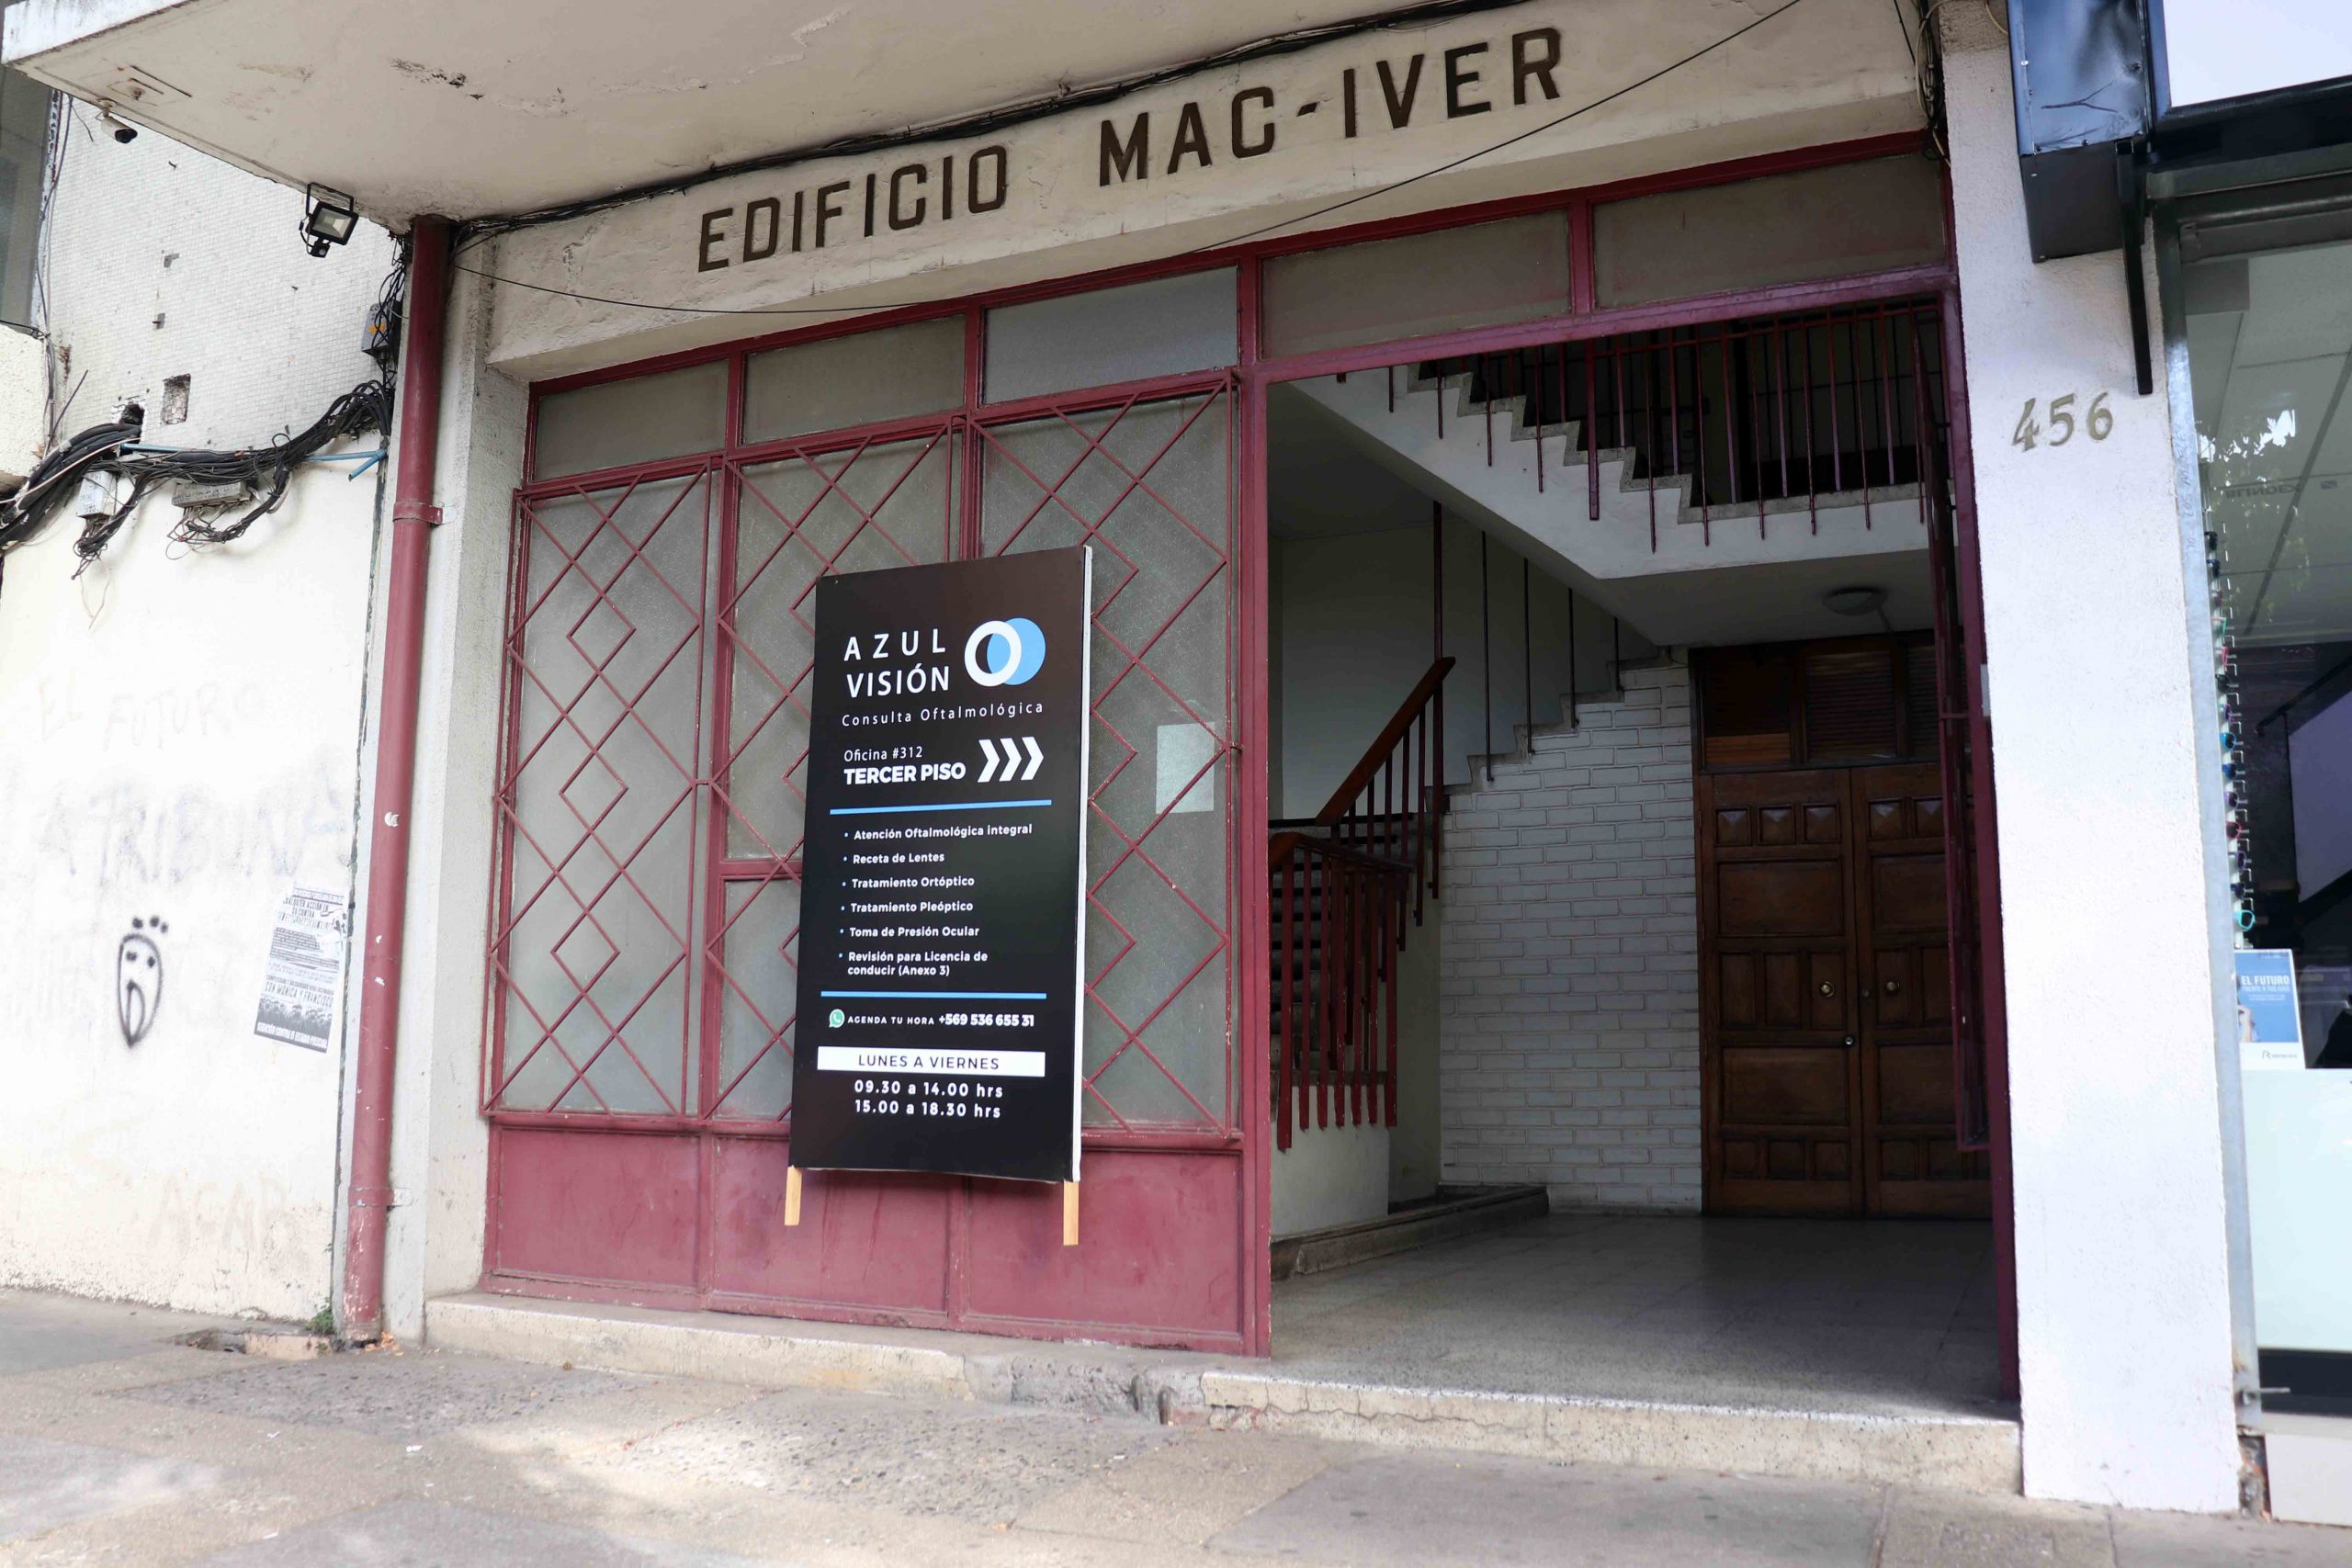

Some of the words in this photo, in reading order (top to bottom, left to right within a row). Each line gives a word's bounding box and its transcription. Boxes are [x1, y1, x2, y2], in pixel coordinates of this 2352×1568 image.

[697, 145, 1009, 273] EDIFICIO
[1100, 27, 1562, 186] MAC-IVER
[2011, 391, 2113, 452] 456
[844, 629, 945, 660] AZUL
[847, 663, 948, 697] VISIÓN
[842, 711, 910, 726] Consulta
[921, 703, 1042, 720] Oftalmológica
[844, 750, 887, 761] Oficina
[893, 746, 922, 759] #312
[844, 765, 916, 784] TERCER
[922, 762, 966, 781] PISO
[854, 829, 901, 840] Atención
[905, 826, 983, 838] Oftalmológica
[988, 824, 1032, 836] integral
[854, 854, 888, 863] Receta
[892, 853, 905, 863] de
[909, 853, 944, 863] Lentes
[852, 877, 918, 887] Tratamiento
[922, 876, 974, 888] Ortóptico
[851, 902, 917, 912] Tratamiento
[921, 901, 973, 913] Pleóptico
[850, 928, 877, 937] Toma
[881, 927, 895, 936] de
[899, 926, 938, 936] Presión
[942, 926, 979, 936] Ocular
[849, 952, 893, 961] Revisión
[898, 953, 921, 964] para
[925, 951, 970, 961] Licencia
[974, 952, 988, 961] de
[848, 964, 895, 975] conducir
[898, 965, 936, 976] (Anexo
[940, 965, 949, 976] 3)
[2241, 976, 2251, 985] EL
[2254, 975, 2289, 985] FUTURO
[939, 1013, 967, 1025] +569
[970, 1014, 993, 1025] 536
[996, 1014, 1019, 1026] 655
[1022, 1015, 1034, 1026] 31
[859, 1055, 907, 1066] LUNES
[914, 1056, 922, 1066] A
[930, 1057, 998, 1069] VIERNES
[854, 1080, 900, 1094] 09.30
[909, 1084, 916, 1094] a
[924, 1082, 968, 1096] 14.00
[977, 1083, 1002, 1098] hrs
[855, 1100, 899, 1113] 15.00
[907, 1104, 914, 1114] a
[922, 1102, 966, 1116] 18.30
[975, 1103, 1000, 1118] hrs
